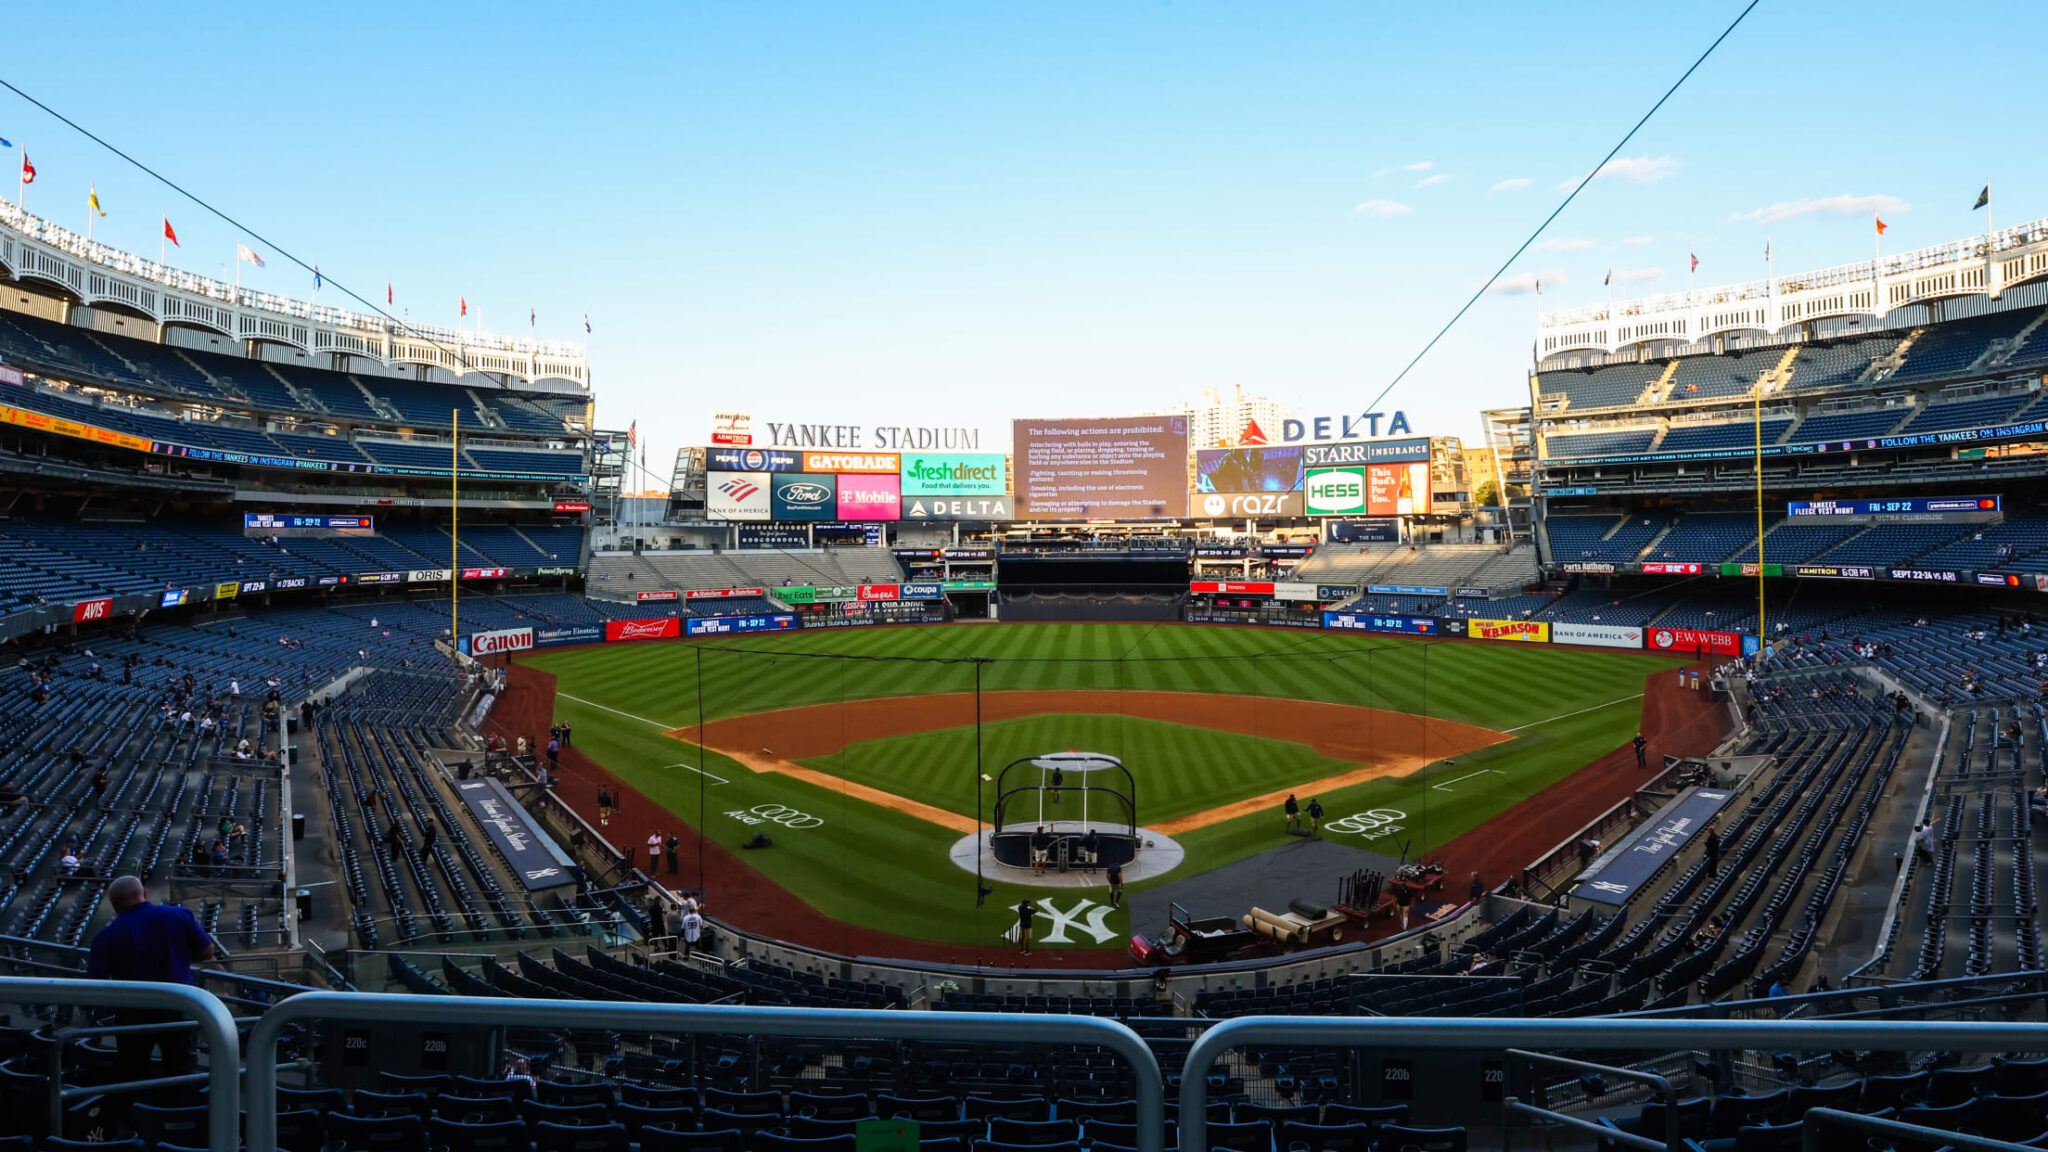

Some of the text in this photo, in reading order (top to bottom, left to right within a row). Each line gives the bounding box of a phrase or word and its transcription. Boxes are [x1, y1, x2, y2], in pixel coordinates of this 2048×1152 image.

[1044, 428, 1080, 437] following
[1123, 425, 1164, 435] prohibited:
[1283, 411, 1412, 442] DELTA
[766, 422, 979, 449] YANKEE STADIUM
[1881, 423, 2043, 447] FOLLOW THE YANKEES ON INSTAGRAM
[189, 449, 327, 470] FOLLOW THE YANKEES ON INSTAGRAM @YANKEES
[715, 455, 739, 463] PEPSI
[770, 456, 793, 464] PEPSI
[1306, 445, 1427, 464] STARR INSURANCE
[809, 455, 896, 469] GATORADE
[914, 459, 997, 480] freshdirect
[1370, 468, 1391, 477] This
[1371, 477, 1395, 485] Bud's
[787, 485, 821, 501] Ford
[1311, 484, 1359, 498] HESS
[1371, 486, 1386, 494] For
[855, 491, 896, 504] Mobile
[1371, 495, 1391, 503] You.
[934, 501, 1006, 515] DELTA
[1232, 495, 1288, 514] razr
[1869, 502, 1912, 511] FRI SEP 22
[1563, 562, 1614, 572] Parts Authority
[416, 571, 443, 580] ORIS
[1892, 569, 1910, 579] SEPT
[1942, 571, 1956, 581] ARI
[794, 591, 813, 599] Eats
[913, 586, 937, 594] coupa
[82, 602, 104, 620] AVIS
[624, 624, 664, 634] Budweiser
[750, 619, 758, 627] SEP
[538, 627, 600, 639] Montefiore Einstein
[1675, 632, 1695, 643] F.W.
[1699, 634, 1732, 645] WEBB
[473, 632, 531, 653] Canon
[723, 810, 766, 825] Audi
[1361, 825, 1405, 840] Audi
[688, 921, 697, 929] 99
[346, 1037, 367, 1049] 220c
[424, 1040, 446, 1052] 220b
[1385, 1068, 1410, 1081] 220b
